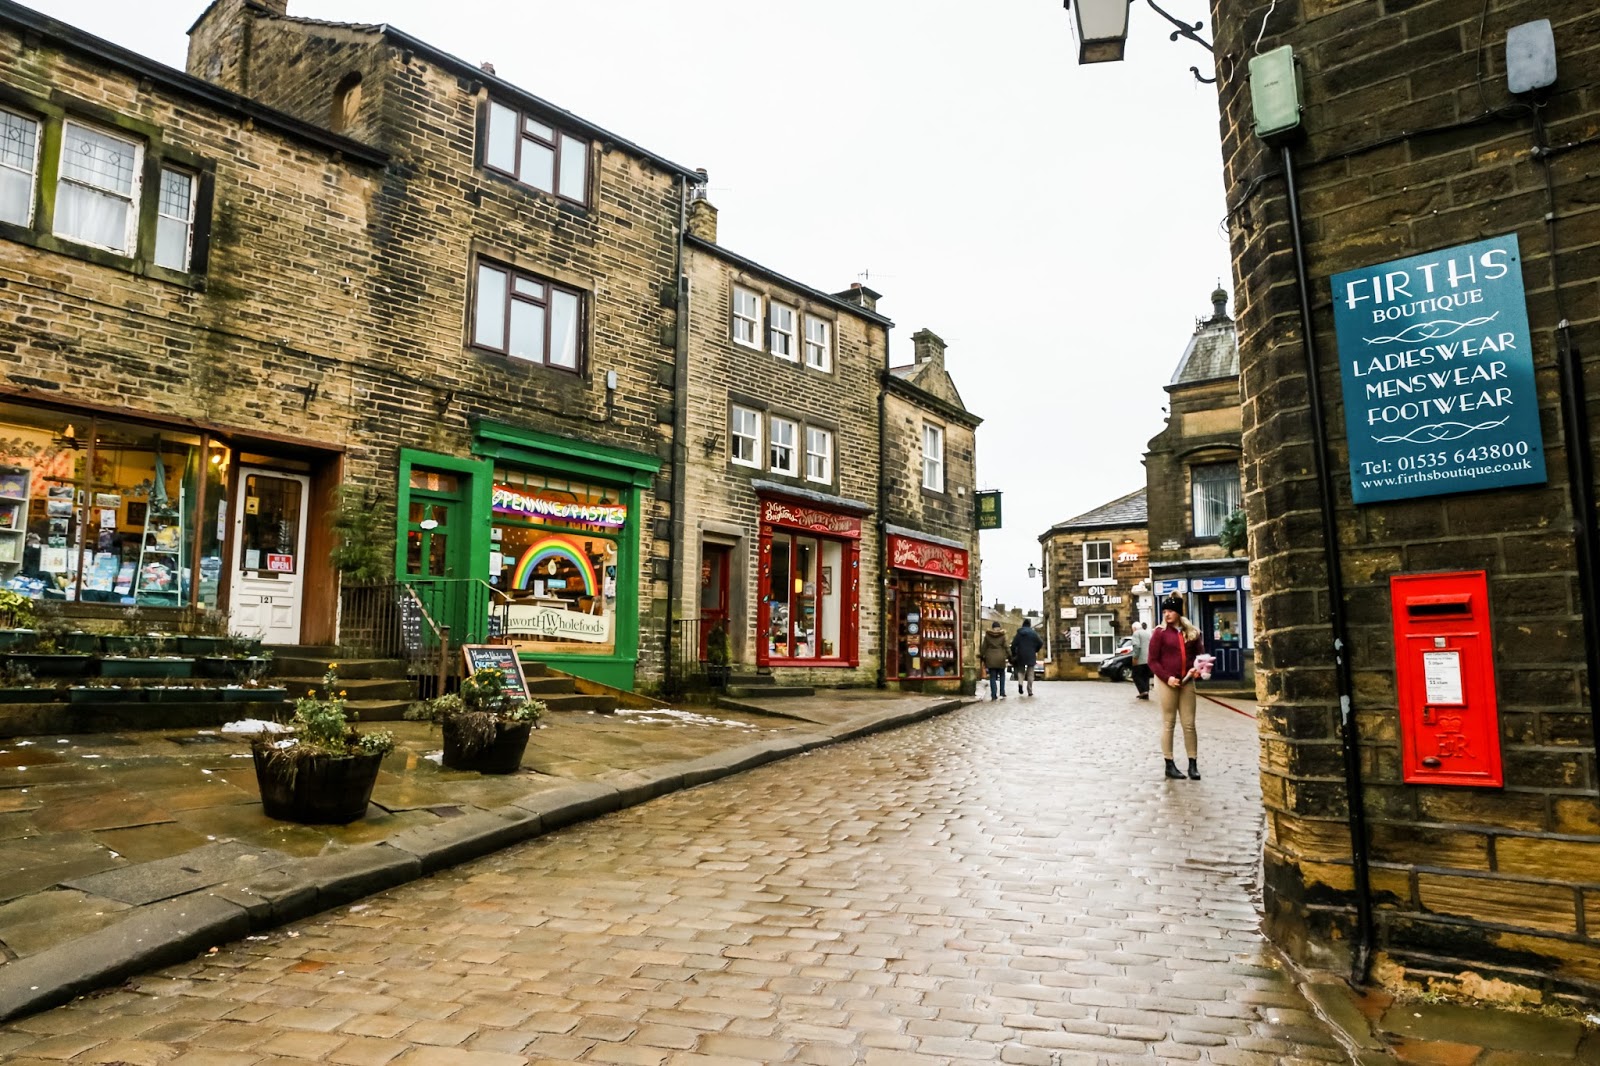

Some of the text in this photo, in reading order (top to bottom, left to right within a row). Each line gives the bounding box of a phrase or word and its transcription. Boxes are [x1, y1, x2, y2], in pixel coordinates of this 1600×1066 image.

[1345, 249, 1508, 310] FIRTHS
[1372, 288, 1484, 324] BOUTIQUE
[1352, 332, 1517, 377] LADIESWEAR
[1365, 361, 1508, 400] MENSWEAR
[1367, 387, 1514, 426] FOOTWEAR
[1360, 458, 1532, 489] www.firthsboutique.co.uk
[1361, 440, 1529, 476] Tel: 01535 643800
[271, 560, 289, 570] OPEN
[260, 596, 273, 604] 121
[1073, 595, 1122, 606] White Lion
[1088, 586, 1105, 596] Old
